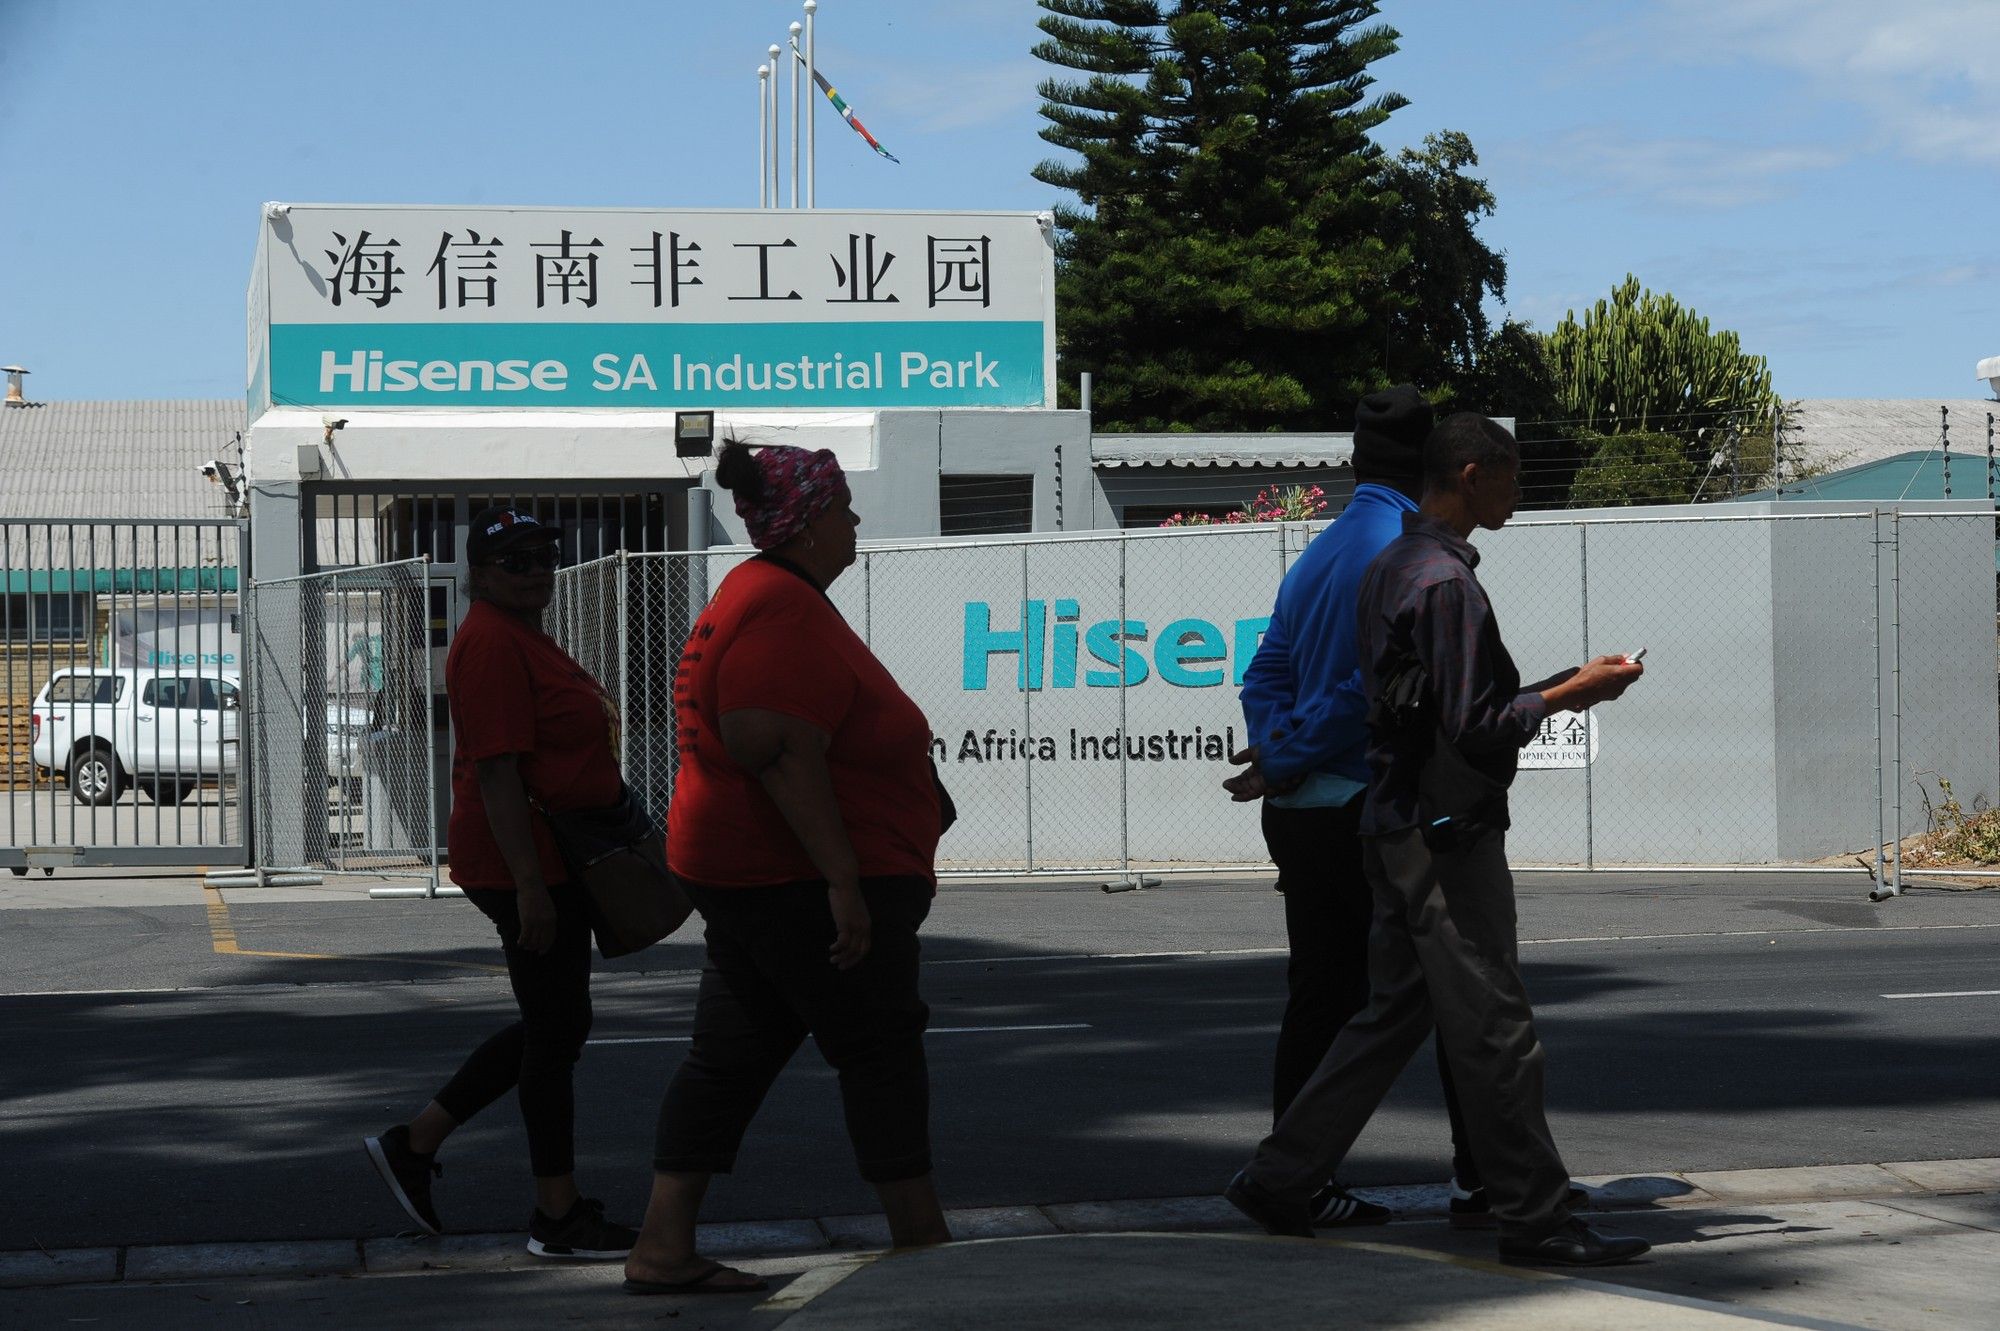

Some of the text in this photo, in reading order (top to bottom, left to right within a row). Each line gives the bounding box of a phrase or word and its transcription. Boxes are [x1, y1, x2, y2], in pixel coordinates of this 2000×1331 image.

[324, 228, 992, 310] 海信南非工业园
[318, 350, 1001, 393] Hisense SA Industrial Park
[957, 728, 1057, 764] Africa
[1070, 725, 1235, 763] Industrial
[1519, 752, 1558, 760] OPMENT
